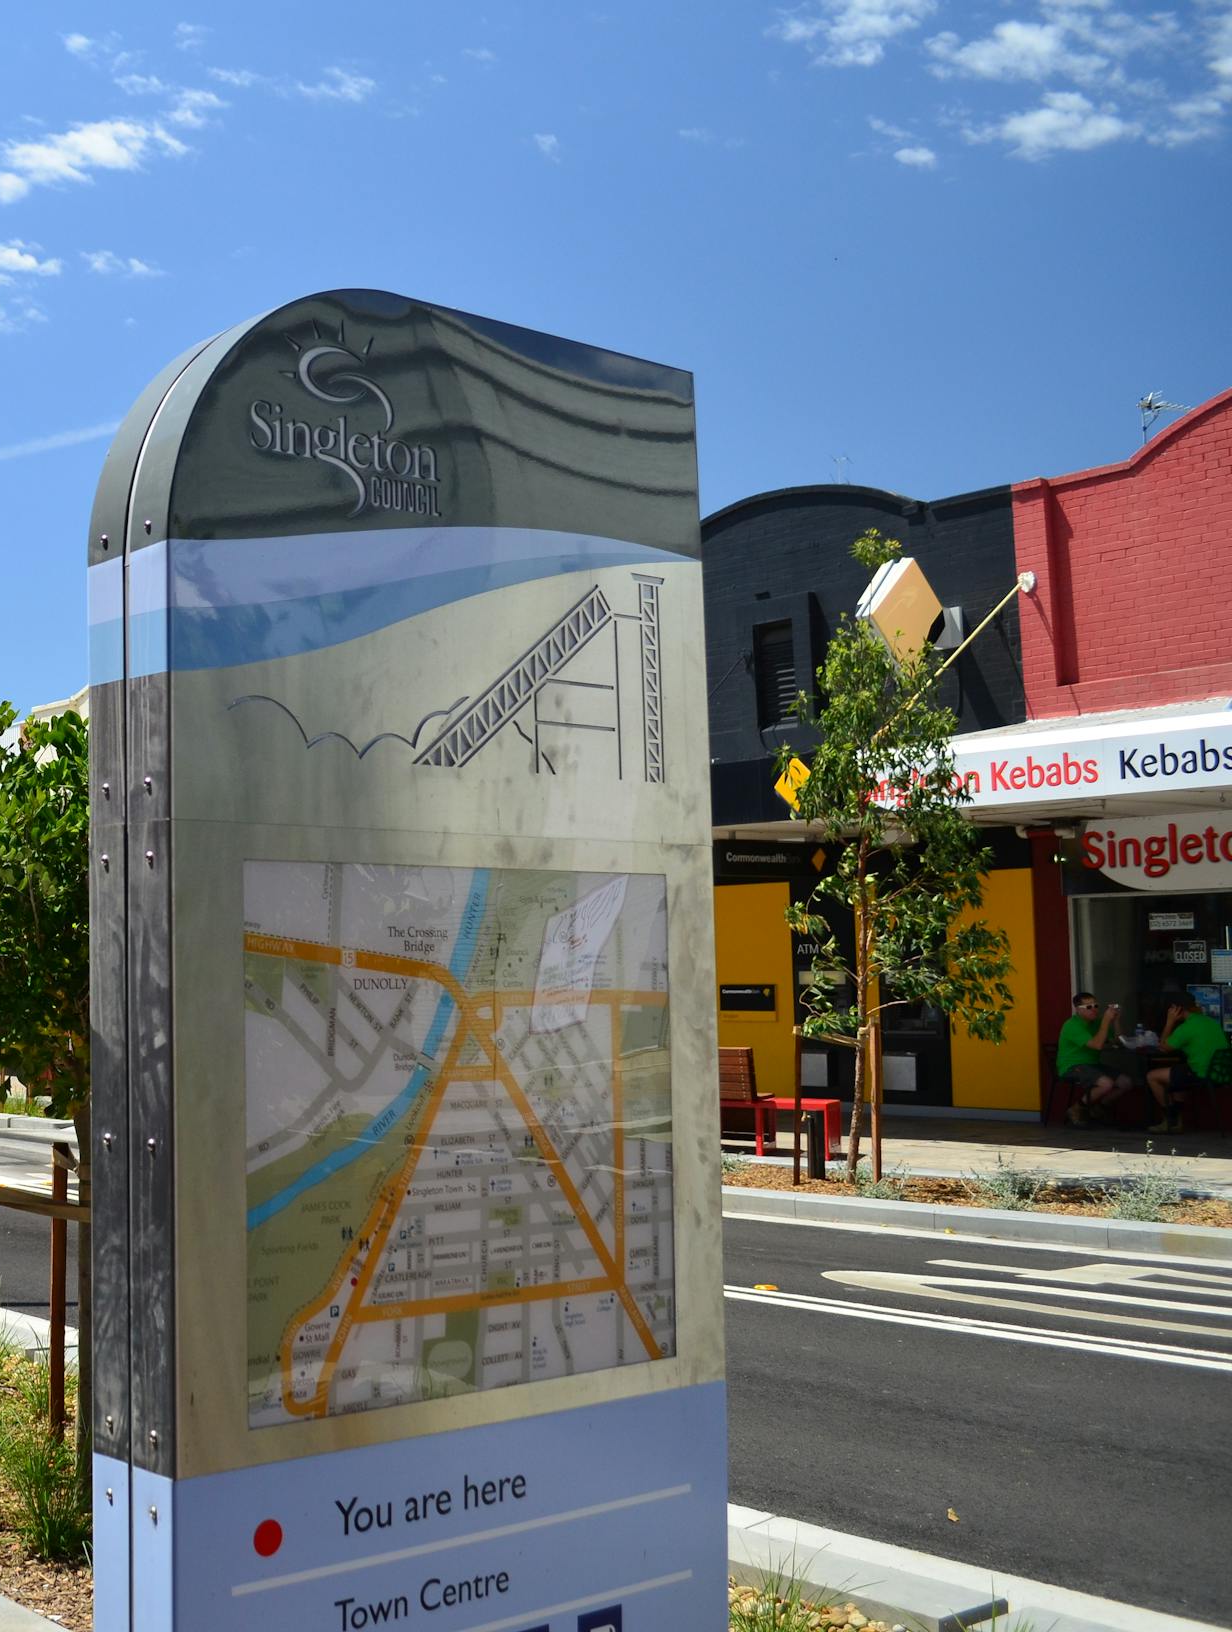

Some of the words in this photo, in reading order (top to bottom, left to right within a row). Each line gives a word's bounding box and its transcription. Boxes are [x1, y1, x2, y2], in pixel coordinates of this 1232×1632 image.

[250, 400, 441, 517] Singleton
[371, 475, 442, 516] COUNCIL
[1119, 739, 1232, 779] Kebabs
[990, 752, 1099, 791] Kebabs
[387, 926, 405, 938] The
[408, 926, 448, 942] Crossing
[247, 936, 296, 953] HIGHWAY
[403, 940, 435, 956] Bridge
[797, 943, 819, 954] ATM
[343, 952, 353, 966] 15
[1175, 951, 1206, 962] CLOSED
[354, 978, 408, 991] DUNOLLY
[449, 1100, 488, 1110] MACQUARIE
[372, 1109, 397, 1137] RIVER
[441, 1136, 476, 1146] ELIZABETH
[437, 1169, 463, 1178] HUNTER
[411, 1185, 444, 1197] Singleton
[445, 1185, 463, 1193] Town
[434, 1202, 461, 1211] WILLIAM
[428, 1237, 444, 1246] PITT
[385, 1271, 432, 1284] CASTLEREAGH
[304, 1323, 331, 1332] Gowrie
[315, 1333, 330, 1342] Mall
[293, 1349, 321, 1360] GOWRIE
[341, 1370, 356, 1379] GAS
[335, 1497, 393, 1536] You
[405, 1491, 452, 1524] are
[463, 1471, 528, 1511] here
[335, 1594, 409, 1632] Town
[420, 1570, 510, 1612] Centre
